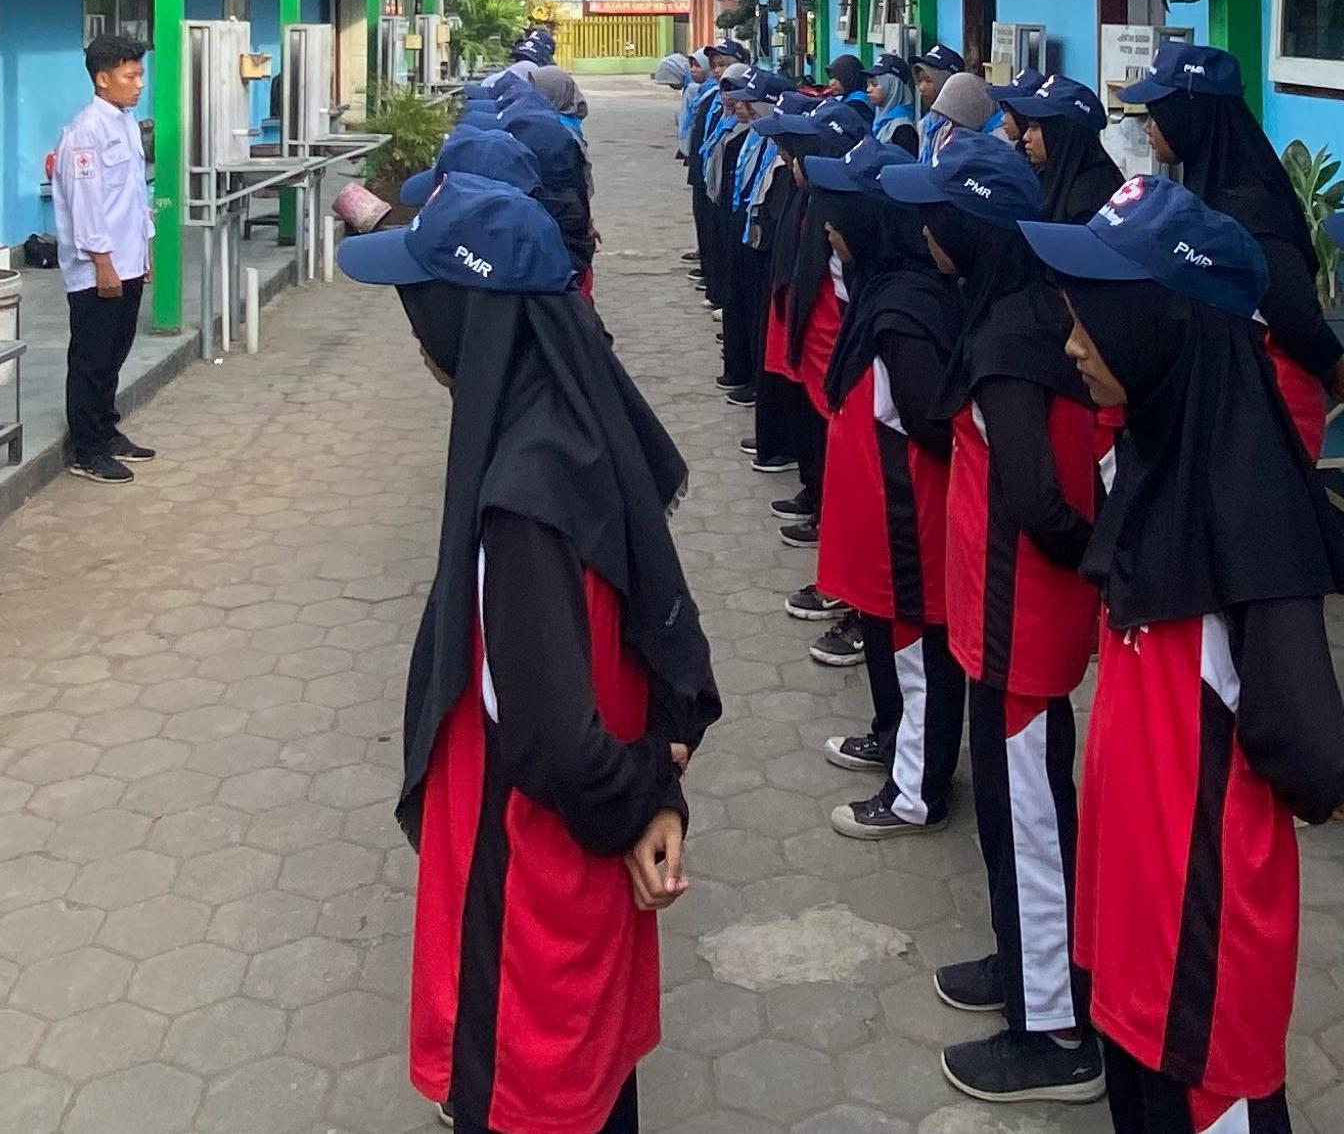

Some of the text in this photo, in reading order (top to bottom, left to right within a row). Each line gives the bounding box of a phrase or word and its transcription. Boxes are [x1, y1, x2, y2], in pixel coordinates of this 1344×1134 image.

[963, 178, 992, 199] PMR
[454, 245, 493, 278] PMR
[1173, 241, 1213, 268] PMR
